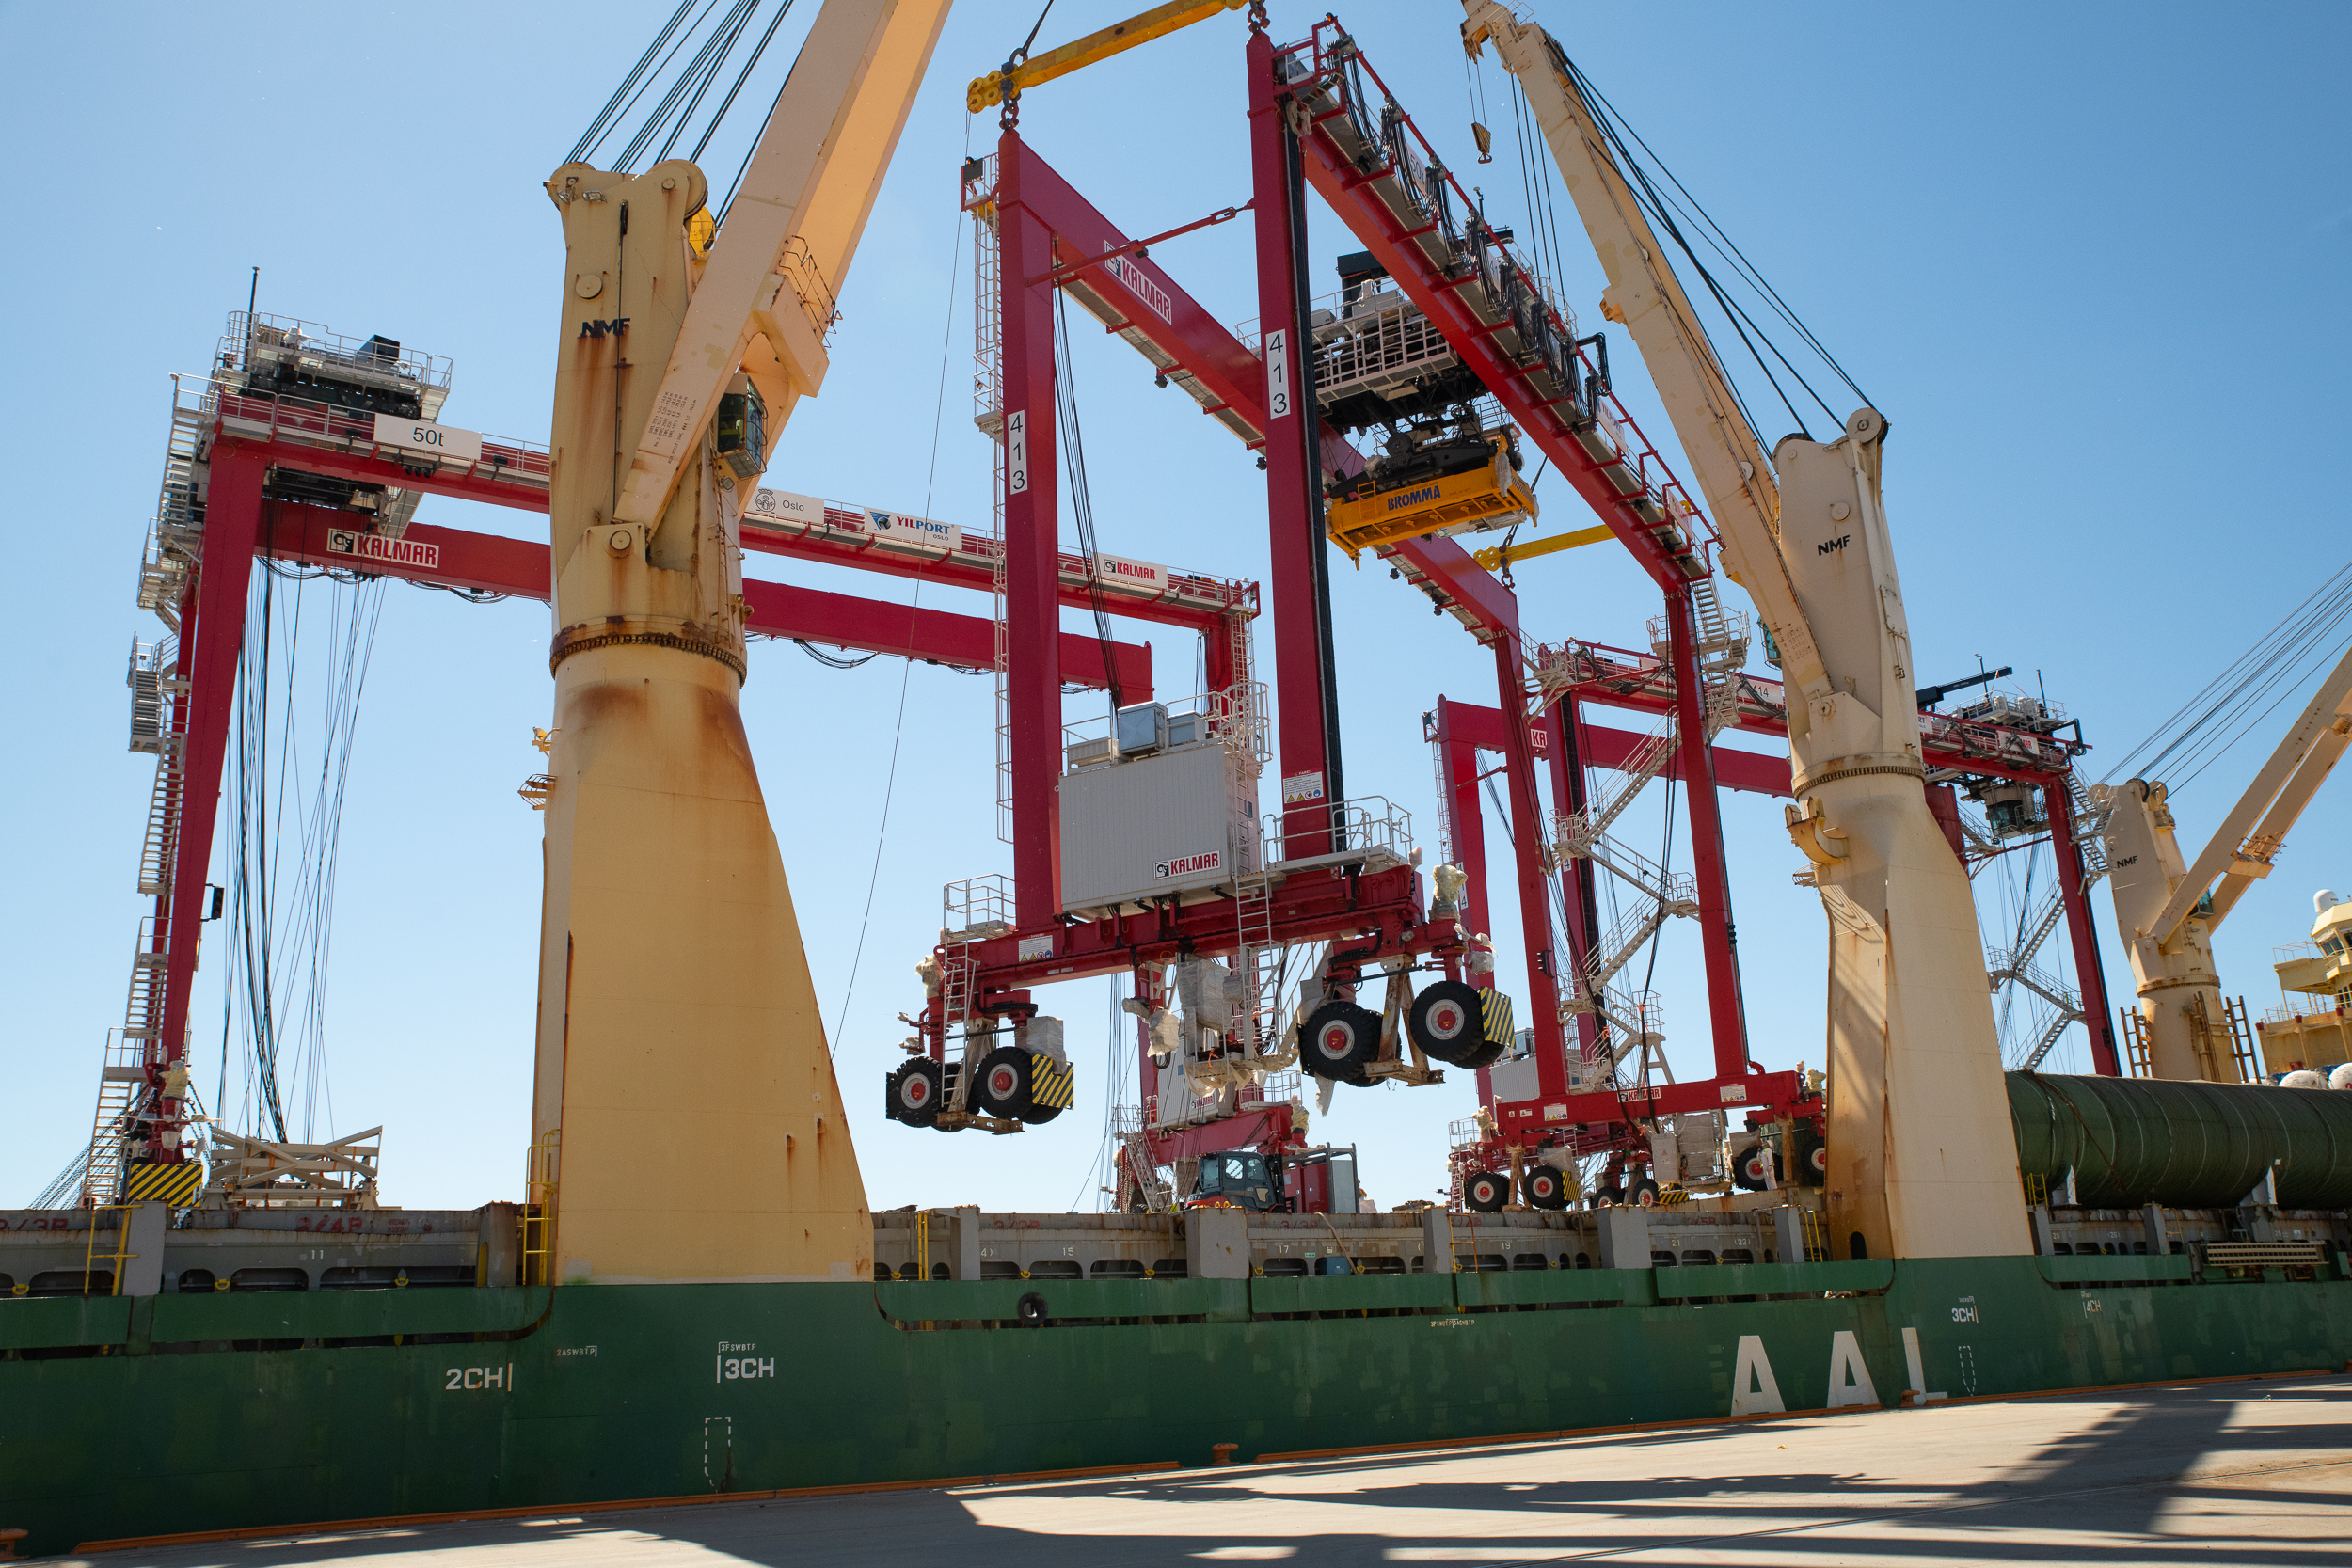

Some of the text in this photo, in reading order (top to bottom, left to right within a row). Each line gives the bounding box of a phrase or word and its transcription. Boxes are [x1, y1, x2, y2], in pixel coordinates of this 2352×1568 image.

[1121, 259, 1171, 323] KALMAR
[581, 318, 630, 337] NMF
[1269, 333, 1287, 414] 413
[412, 427, 444, 447] 50t
[1010, 414, 1025, 490] 413
[782, 499, 804, 512] Oslo
[1387, 485, 1441, 511] BROMMA
[897, 516, 950, 535] YILPORT
[358, 535, 437, 565] KALMAR
[1817, 534, 1851, 556] NMF
[1117, 562, 1156, 580] KALMAR
[1170, 852, 1219, 875] KALMAR
[2116, 855, 2137, 869] NMF
[1062, 1246, 1074, 1256] 15
[1279, 1244, 1290, 1254] 17
[1502, 1242, 1511, 1250] 19
[1671, 1239, 1680, 1247] 21
[1734, 1238, 1751, 1246] (22)
[311, 1249, 325, 1260] 11
[1951, 1307, 1975, 1323] 3CH
[724, 1357, 775, 1380] 3CH
[445, 1367, 503, 1390] 2CH
